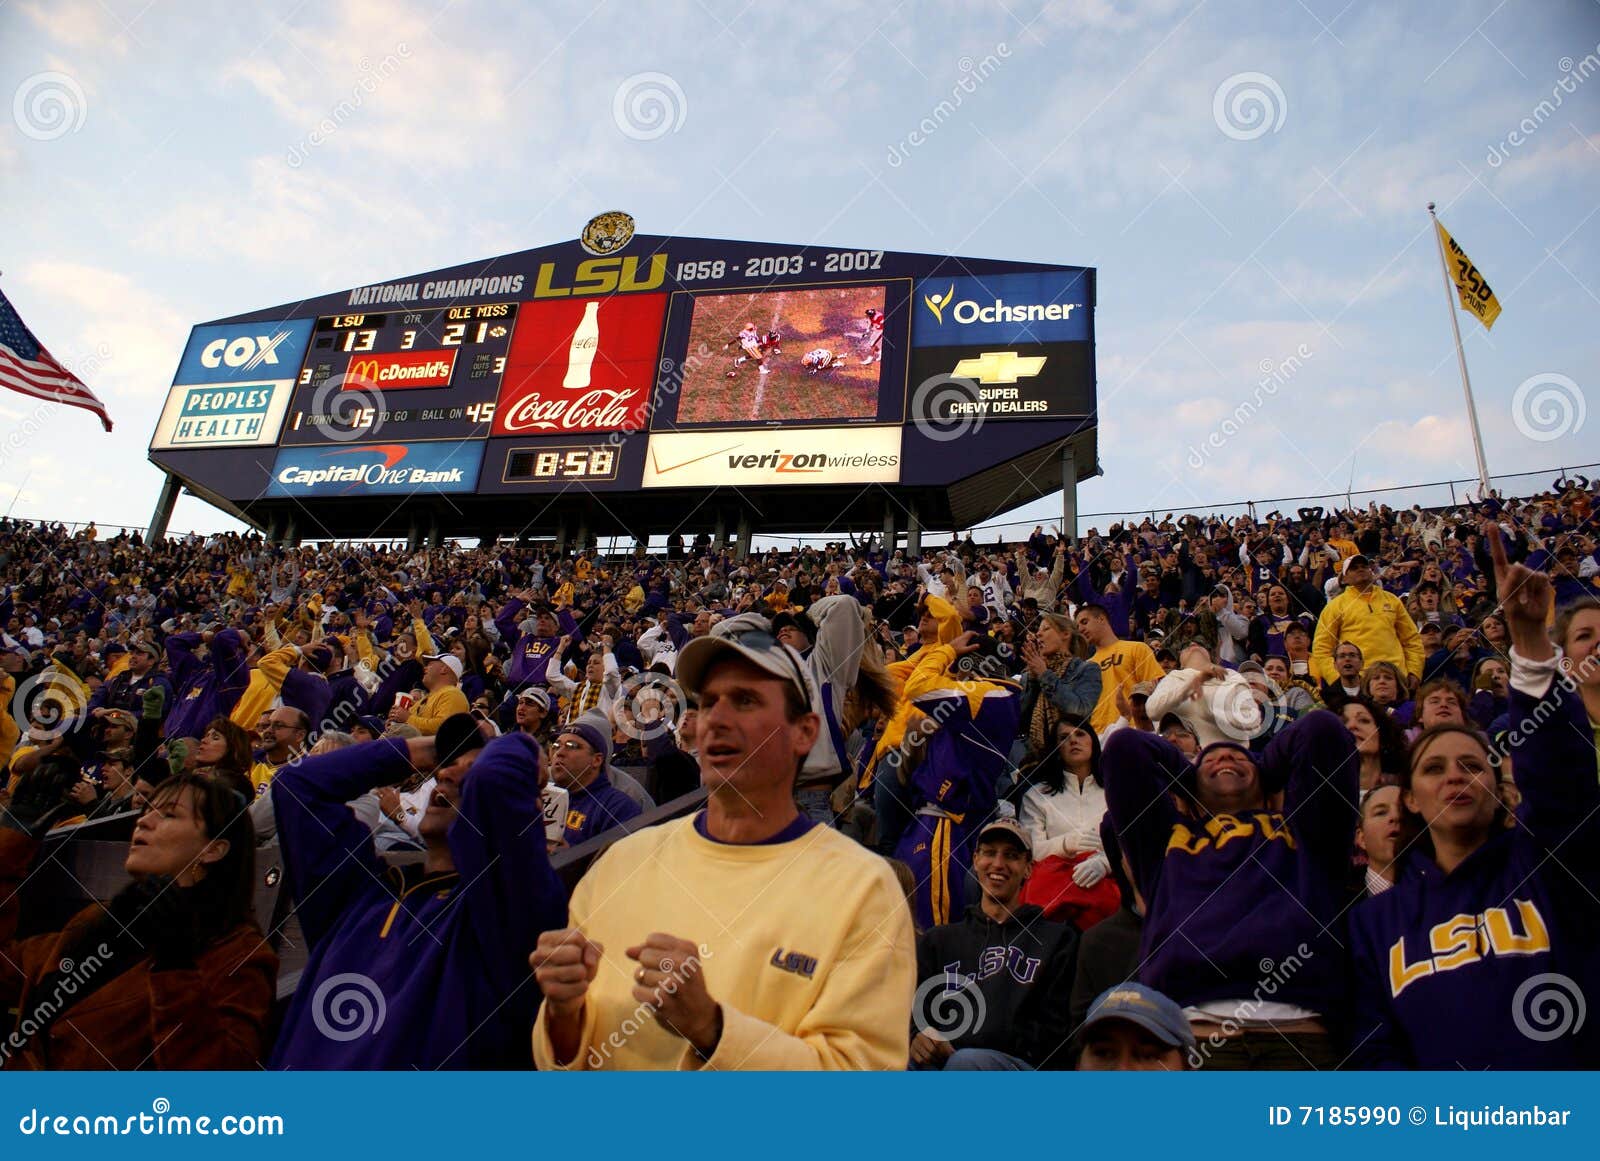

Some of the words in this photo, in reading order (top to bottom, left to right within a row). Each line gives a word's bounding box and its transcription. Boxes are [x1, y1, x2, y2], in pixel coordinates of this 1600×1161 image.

[676, 260, 726, 281] 1958
[745, 255, 803, 277] 2003
[823, 250, 885, 272] 2007
[534, 254, 668, 298] LSU
[348, 282, 419, 306] NATIONAL
[422, 275, 525, 300] CHAMPIONS
[449, 307, 471, 320] OLE
[477, 305, 509, 317] MISS
[953, 299, 1074, 324] Ochsner
[333, 315, 364, 328] LSU
[344, 330, 377, 351] 13
[400, 331, 416, 349] 3
[442, 323, 488, 346] 21
[201, 330, 293, 372] COX
[349, 360, 449, 384] McDonald's
[471, 370, 487, 378] LEFT
[473, 362, 489, 370] OUTS
[493, 357, 506, 373] 3
[300, 369, 313, 385] 3
[187, 390, 269, 411] PEOPLES
[979, 388, 1018, 399] SUPER
[379, 412, 391, 421] TO
[395, 411, 408, 421] GO
[422, 411, 444, 420] BALL
[450, 409, 462, 418] ON
[465, 403, 495, 423] 45
[950, 402, 990, 414] CHEVY
[993, 400, 1048, 412] DEALERS
[178, 418, 260, 438] HEALTH
[293, 412, 303, 430] 1
[306, 415, 333, 425] DOWN
[352, 409, 375, 428] 15
[534, 450, 613, 476] 8:58
[409, 468, 464, 483] Bank
[525, 642, 551, 654] LSU
[1100, 652, 1123, 671] SU
[1389, 898, 1551, 1000] LSU
[770, 948, 817, 977] LSU
[943, 945, 1040, 997] LSU
